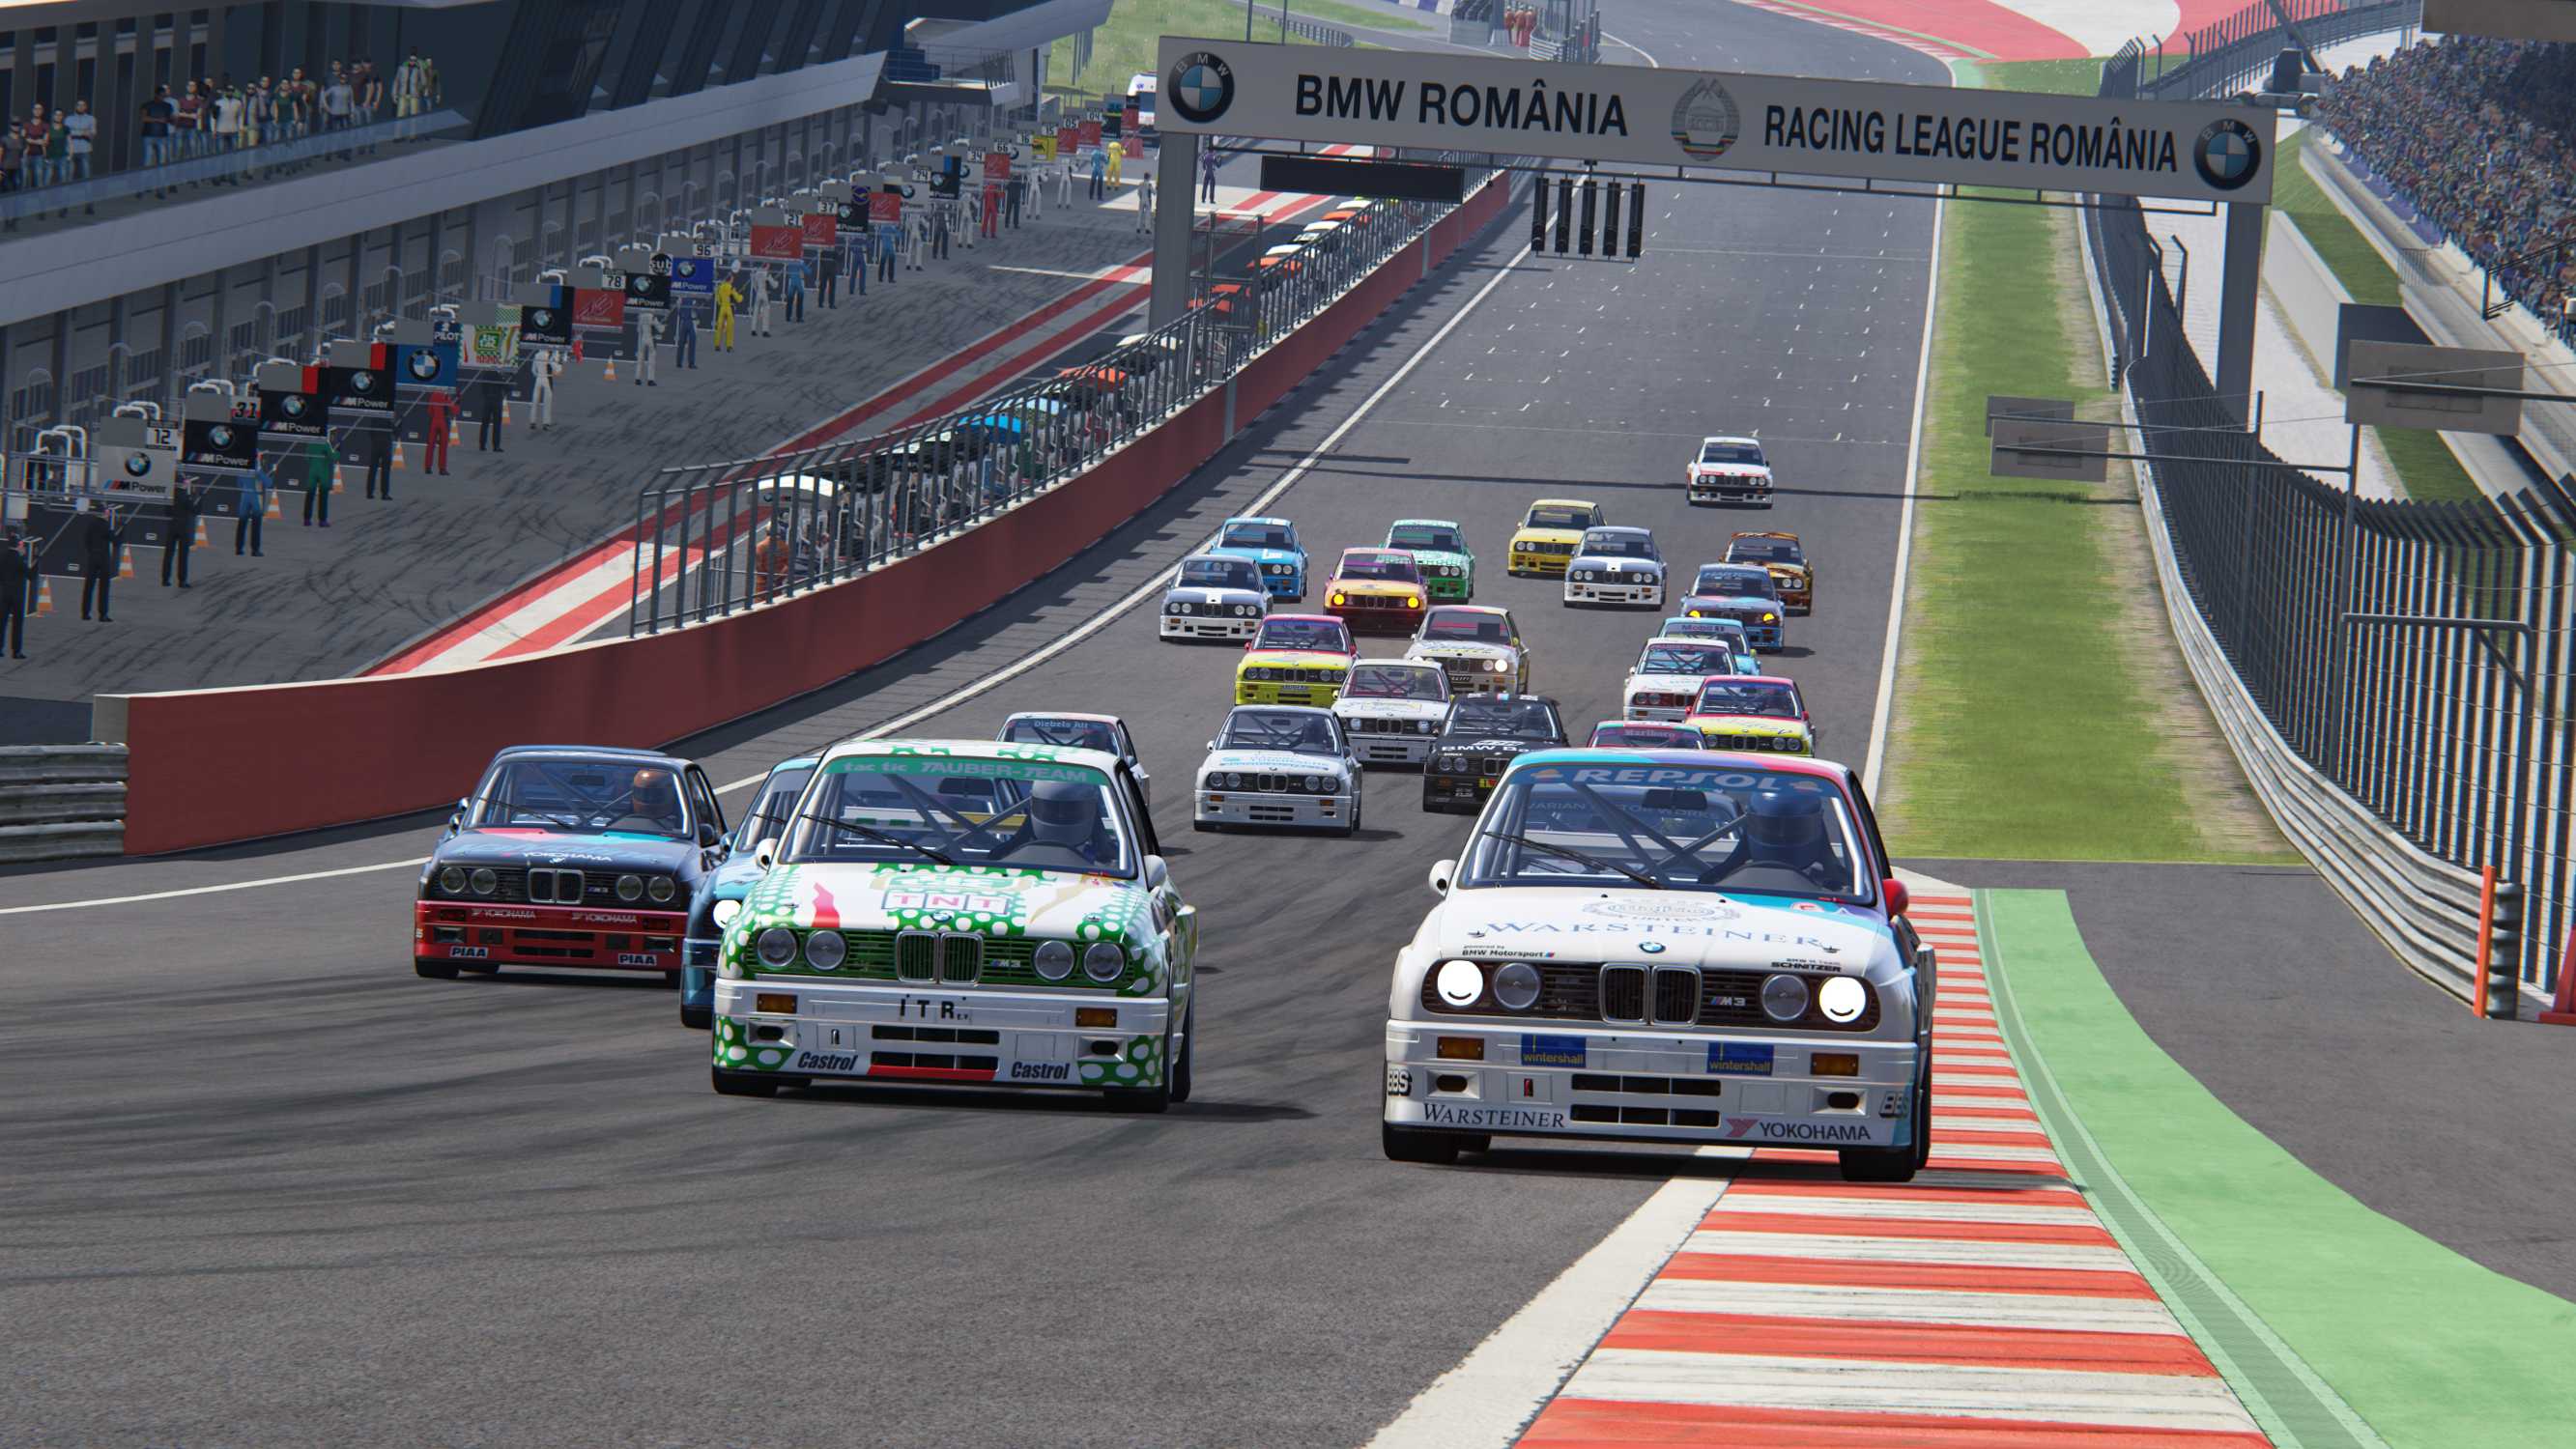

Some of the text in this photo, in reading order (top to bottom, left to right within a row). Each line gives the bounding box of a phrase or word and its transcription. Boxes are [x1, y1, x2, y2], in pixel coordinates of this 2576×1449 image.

[1295, 73, 1629, 137] BMW ROMÂNIA
[1763, 104, 2178, 173] RACING LEAGUE ROMÂNIA
[154, 428, 172, 445] 12
[1572, 768, 1782, 791] REPSOL
[523, 851, 613, 863] YOKOHAMA
[483, 908, 536, 919] YOKOHAMA
[585, 912, 638, 923] YOKOHAMA
[1486, 922, 1824, 948] WARSTEINER
[451, 948, 487, 957] PIAA
[619, 954, 656, 965] PIAA
[1490, 950, 1544, 958] Motorsport
[1770, 961, 1842, 973] SCHNITZER
[1718, 996, 1747, 1007] M3
[797, 1051, 858, 1071] Castrol
[1523, 1051, 1586, 1065] wintershall
[1011, 1061, 1070, 1081] Castrol
[1709, 1060, 1771, 1073] wintershall
[1387, 1068, 1412, 1096] BBS
[1422, 1102, 1565, 1129] WARSTEINER
[1759, 1121, 1872, 1141] YOKOHAMA
